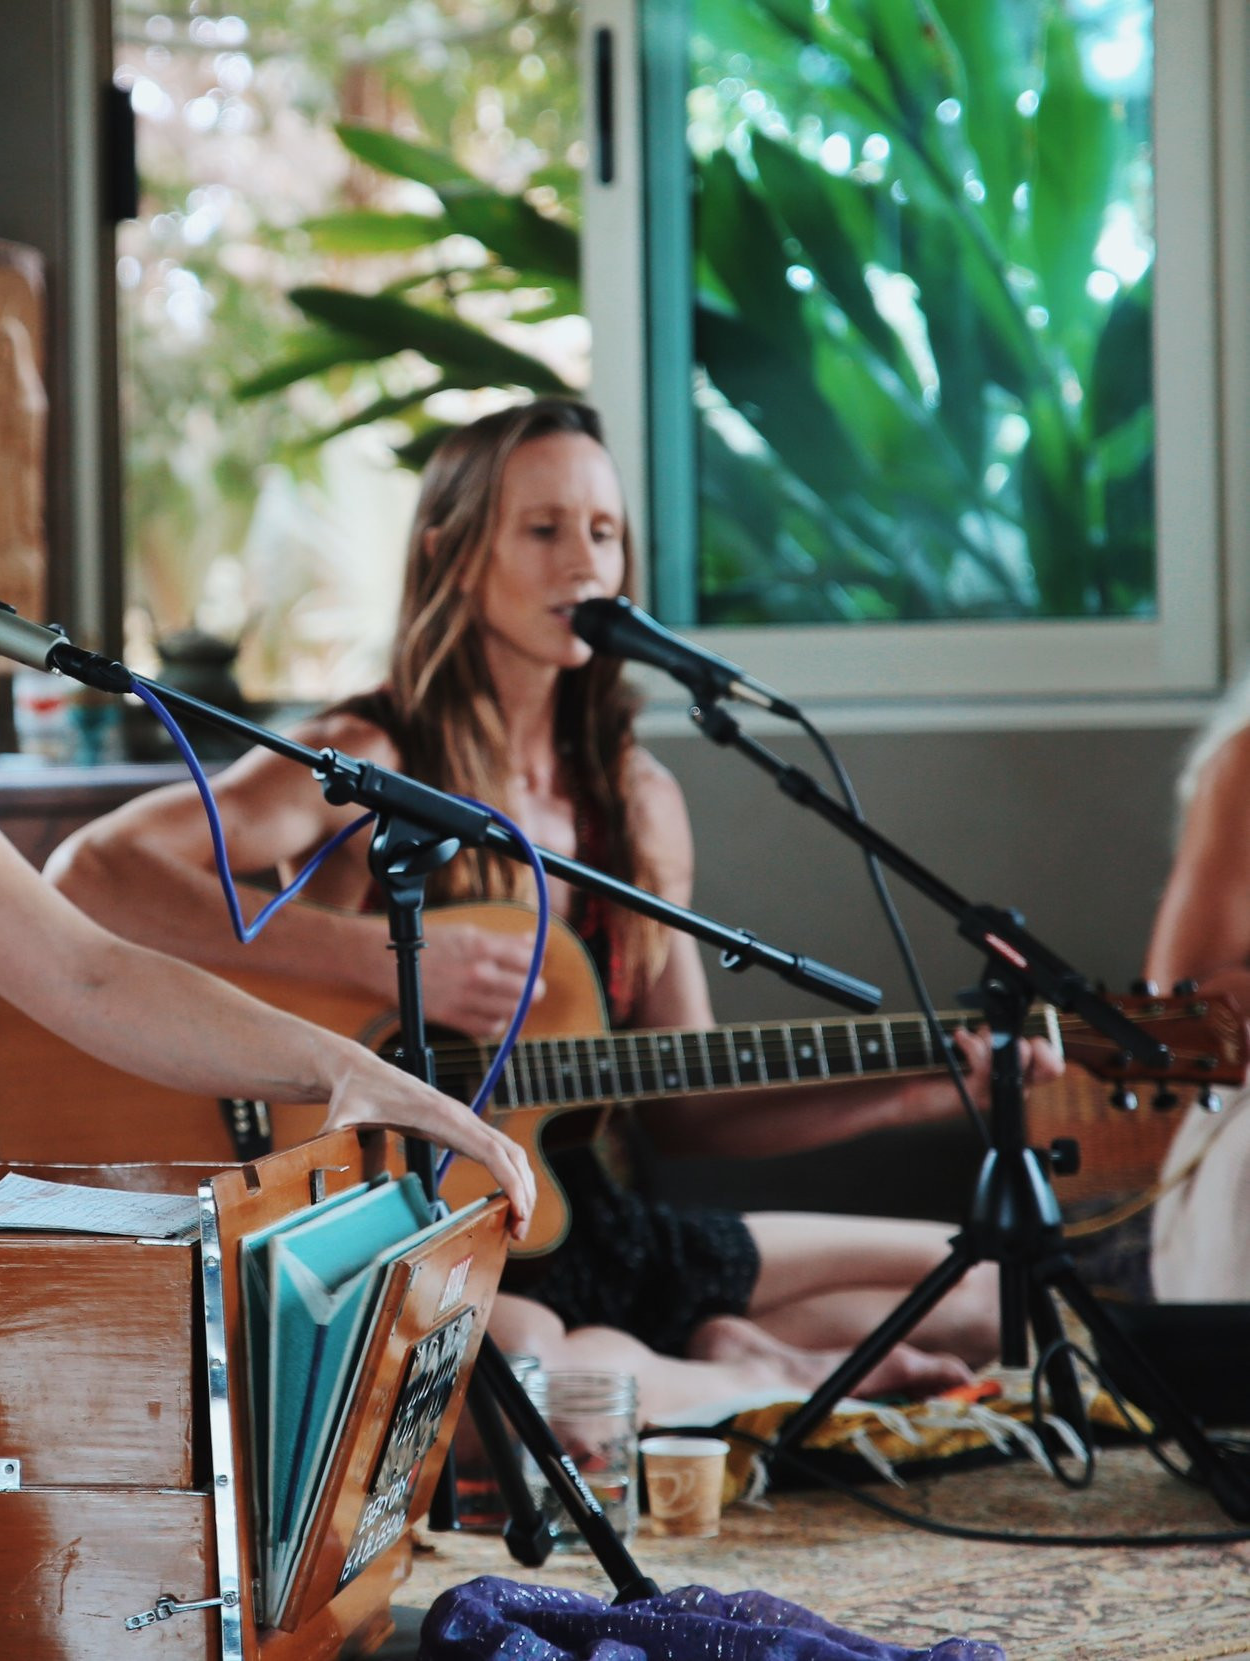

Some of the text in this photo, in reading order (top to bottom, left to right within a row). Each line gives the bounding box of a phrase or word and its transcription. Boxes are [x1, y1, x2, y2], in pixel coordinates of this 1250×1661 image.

[359, 1470, 412, 1535] EVERY DAY
[340, 1508, 406, 1582] IS A BLESSING
